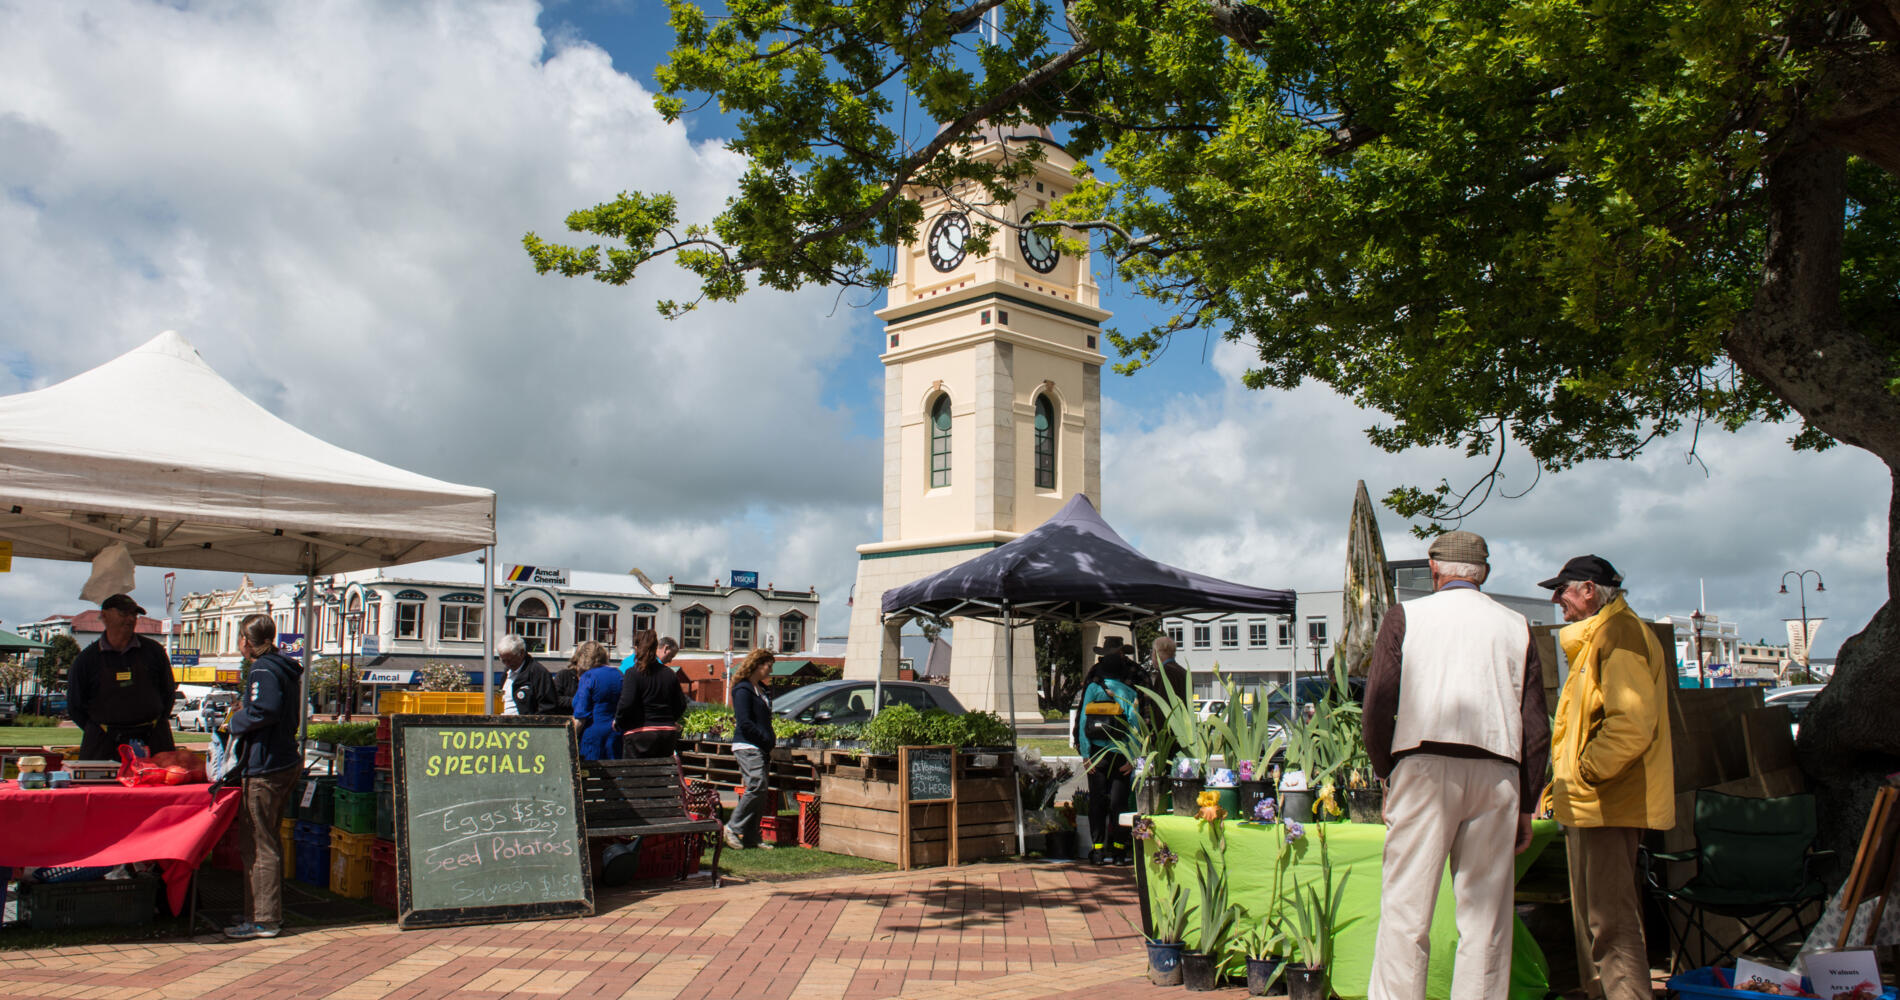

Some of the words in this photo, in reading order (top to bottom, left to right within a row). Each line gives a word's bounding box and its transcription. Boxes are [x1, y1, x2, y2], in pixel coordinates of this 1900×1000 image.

[535, 568, 560, 577] Amcal
[733, 575, 756, 584] VISIQUE
[533, 576, 566, 585] Chemist
[371, 673, 400, 681] Amcal
[438, 730, 531, 750] TODAYS
[425, 754, 546, 777] SPECIALS
[443, 810, 507, 835] Eggs
[511, 799, 567, 822] $5.50
[424, 842, 482, 874] Seed
[492, 836, 573, 861] Potatoes
